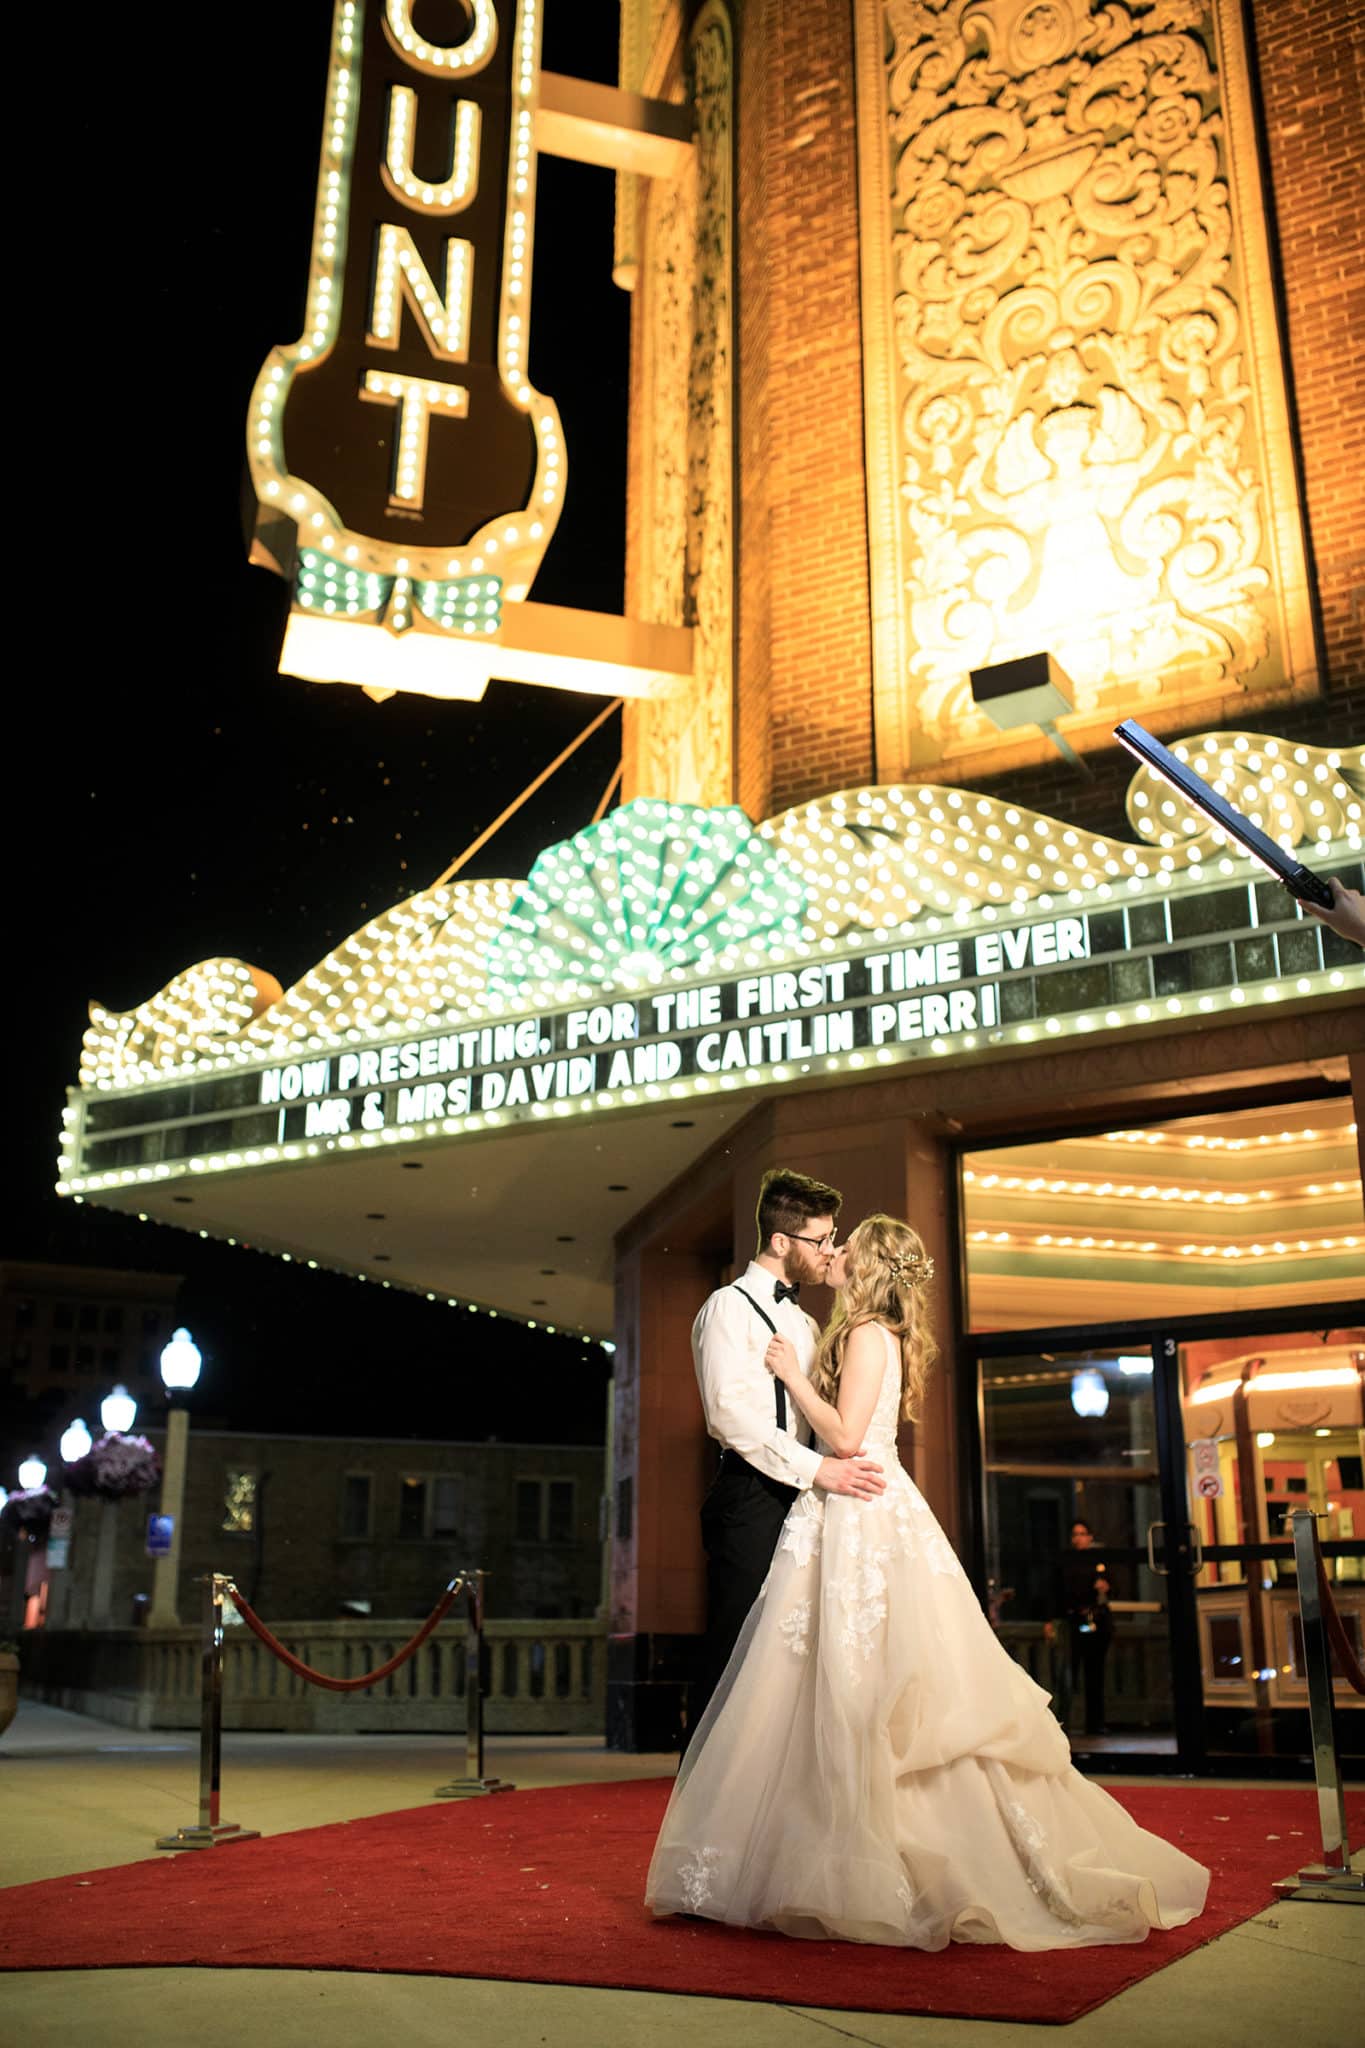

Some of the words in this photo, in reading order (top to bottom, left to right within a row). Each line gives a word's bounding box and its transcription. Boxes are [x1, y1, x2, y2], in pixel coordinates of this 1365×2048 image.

[261, 1060, 327, 1104] NOW
[338, 1021, 551, 1091] PRESENTING,
[567, 1002, 636, 1050] FOR
[652, 986, 721, 1034] THE
[737, 962, 850, 1019] FIRST
[865, 942, 961, 996] TIME
[975, 917, 1086, 976] EVER
[305, 1098, 351, 1137] MR
[361, 1090, 384, 1131] &
[397, 1077, 469, 1124] MRS
[481, 1058, 592, 1110] DAVID
[608, 1041, 681, 1088] AND
[696, 1011, 855, 1074] CAITLIN
[869, 984, 997, 1046] PERRI
[1164, 1339, 1176, 1356] 3
